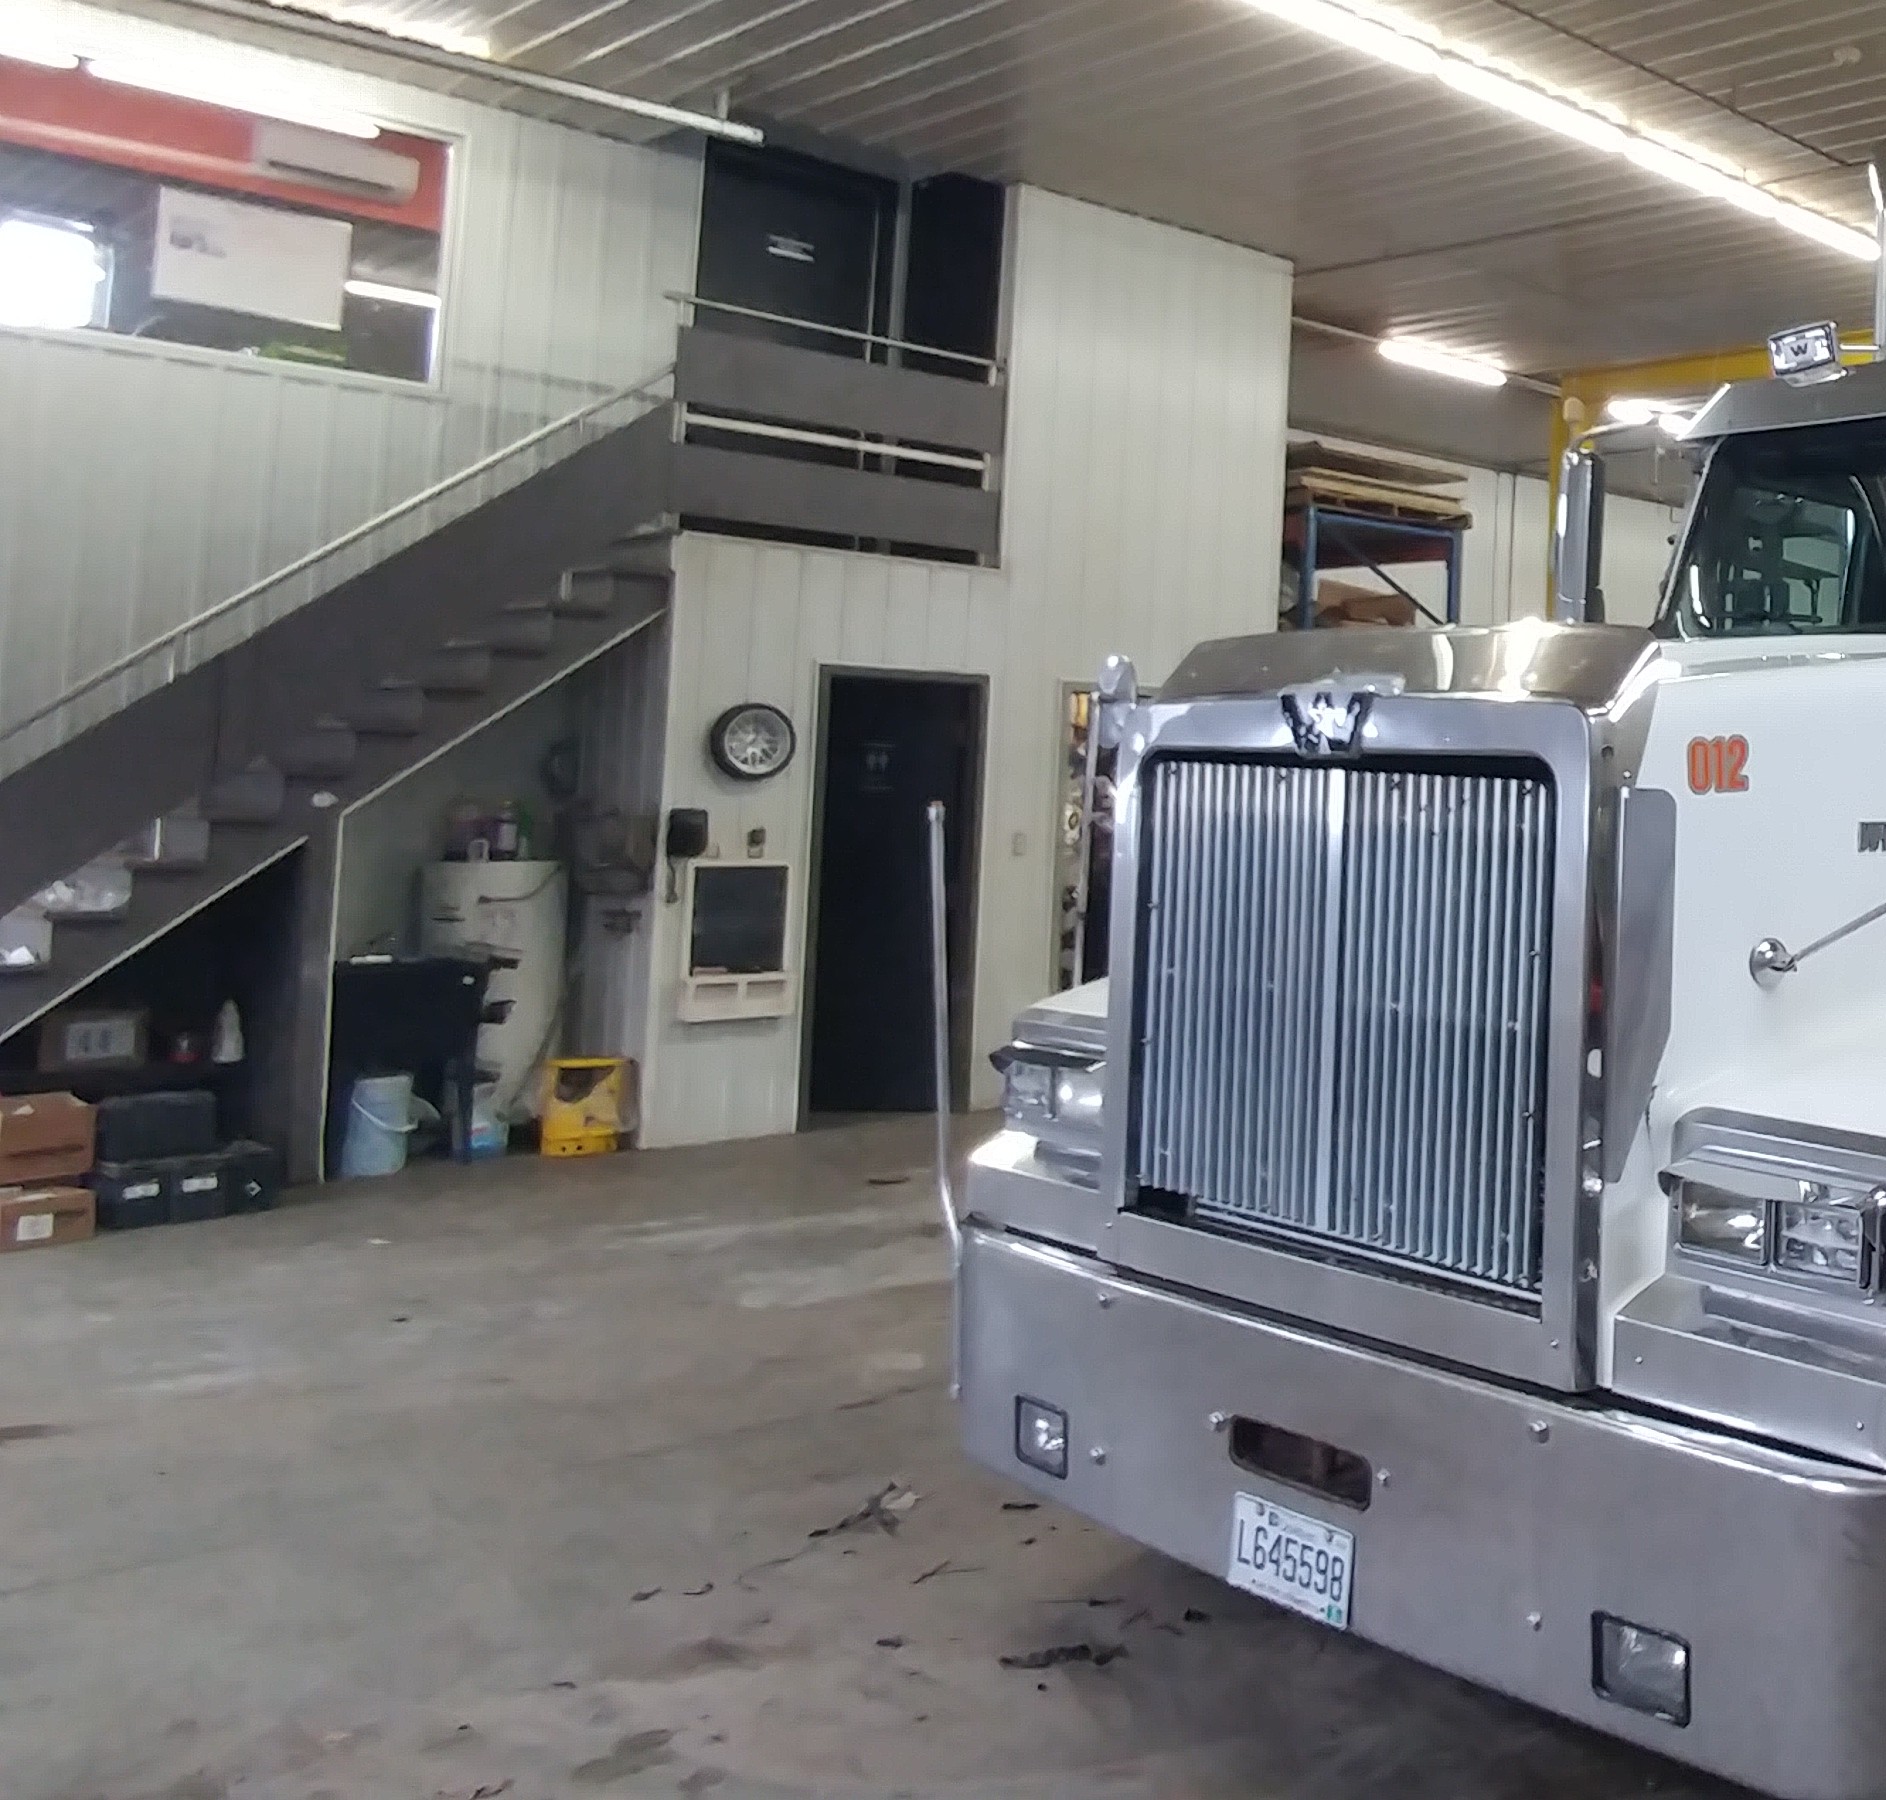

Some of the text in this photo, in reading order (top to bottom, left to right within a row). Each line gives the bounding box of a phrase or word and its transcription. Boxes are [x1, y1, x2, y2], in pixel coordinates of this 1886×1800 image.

[1789, 342, 1808, 357] W
[1686, 733, 1750, 796] 012
[1236, 1518, 1345, 1602] L645598
